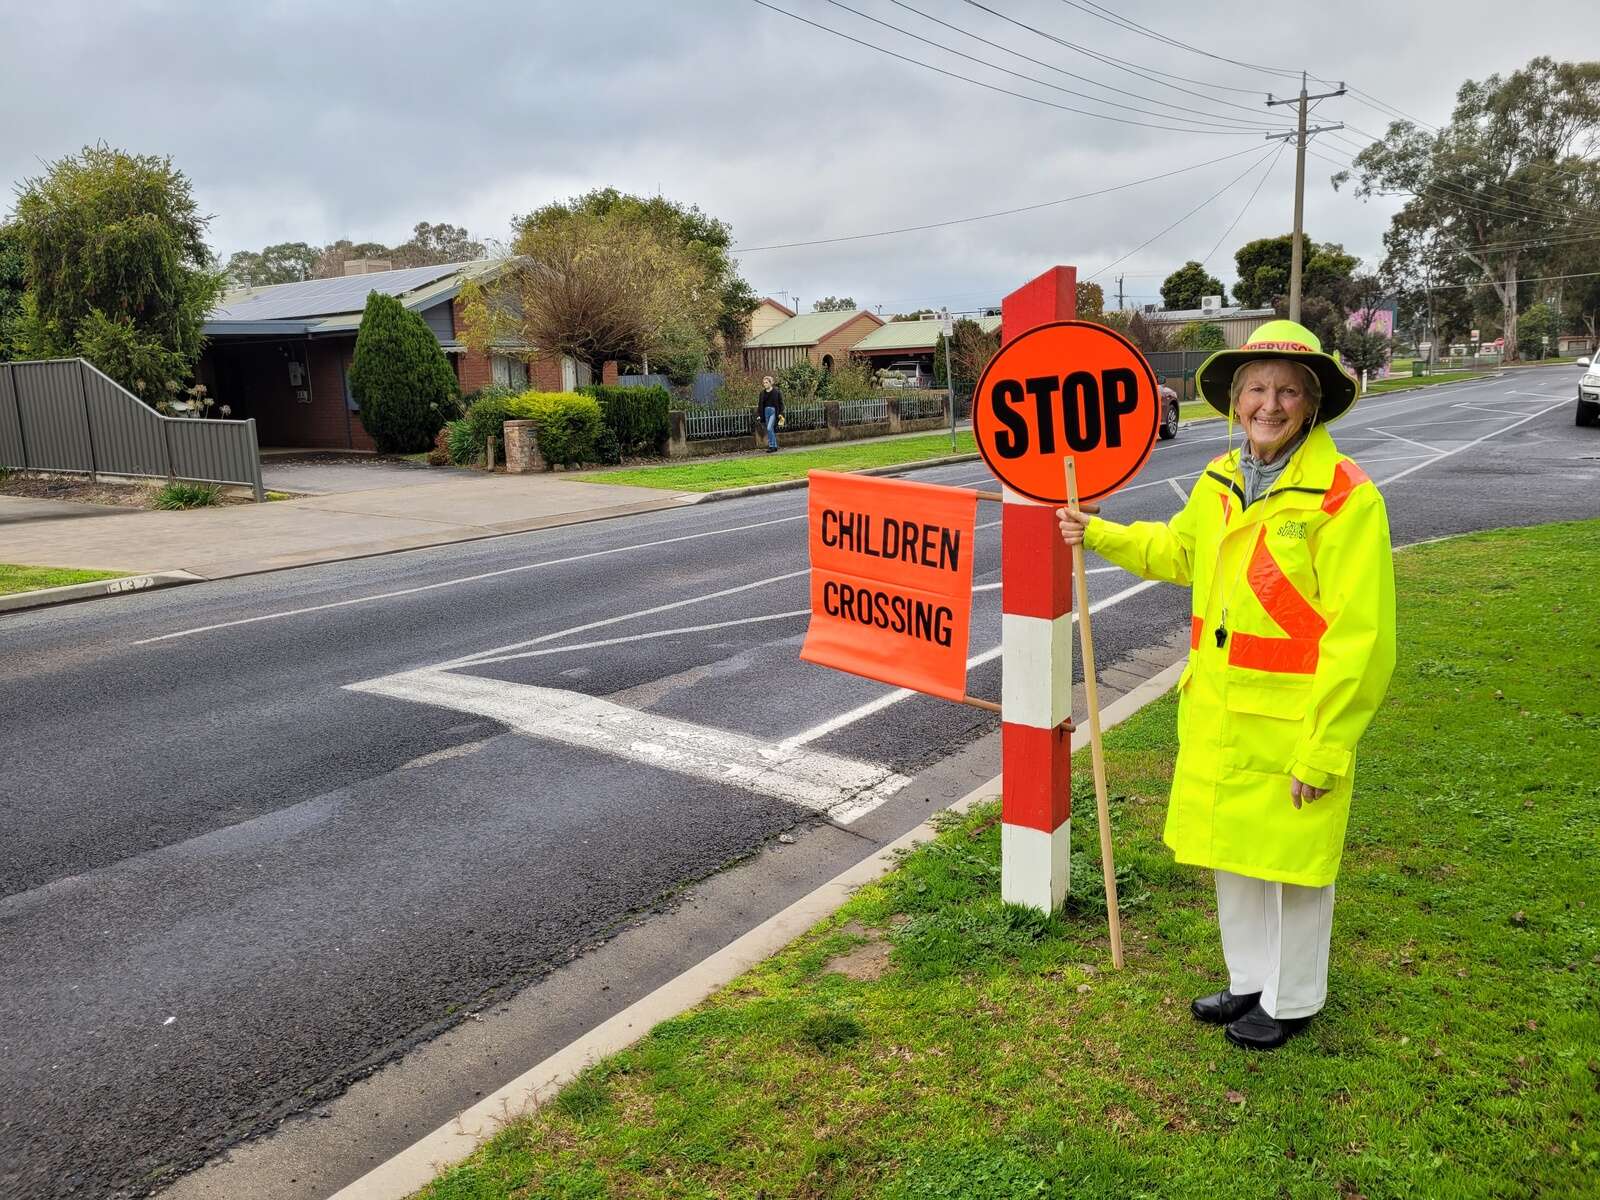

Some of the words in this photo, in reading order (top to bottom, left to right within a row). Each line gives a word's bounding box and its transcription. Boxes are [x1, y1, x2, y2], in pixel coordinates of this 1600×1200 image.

[991, 368, 1139, 459] STOP
[821, 509, 961, 572] CHILDREN
[823, 581, 953, 648] CROSSING
